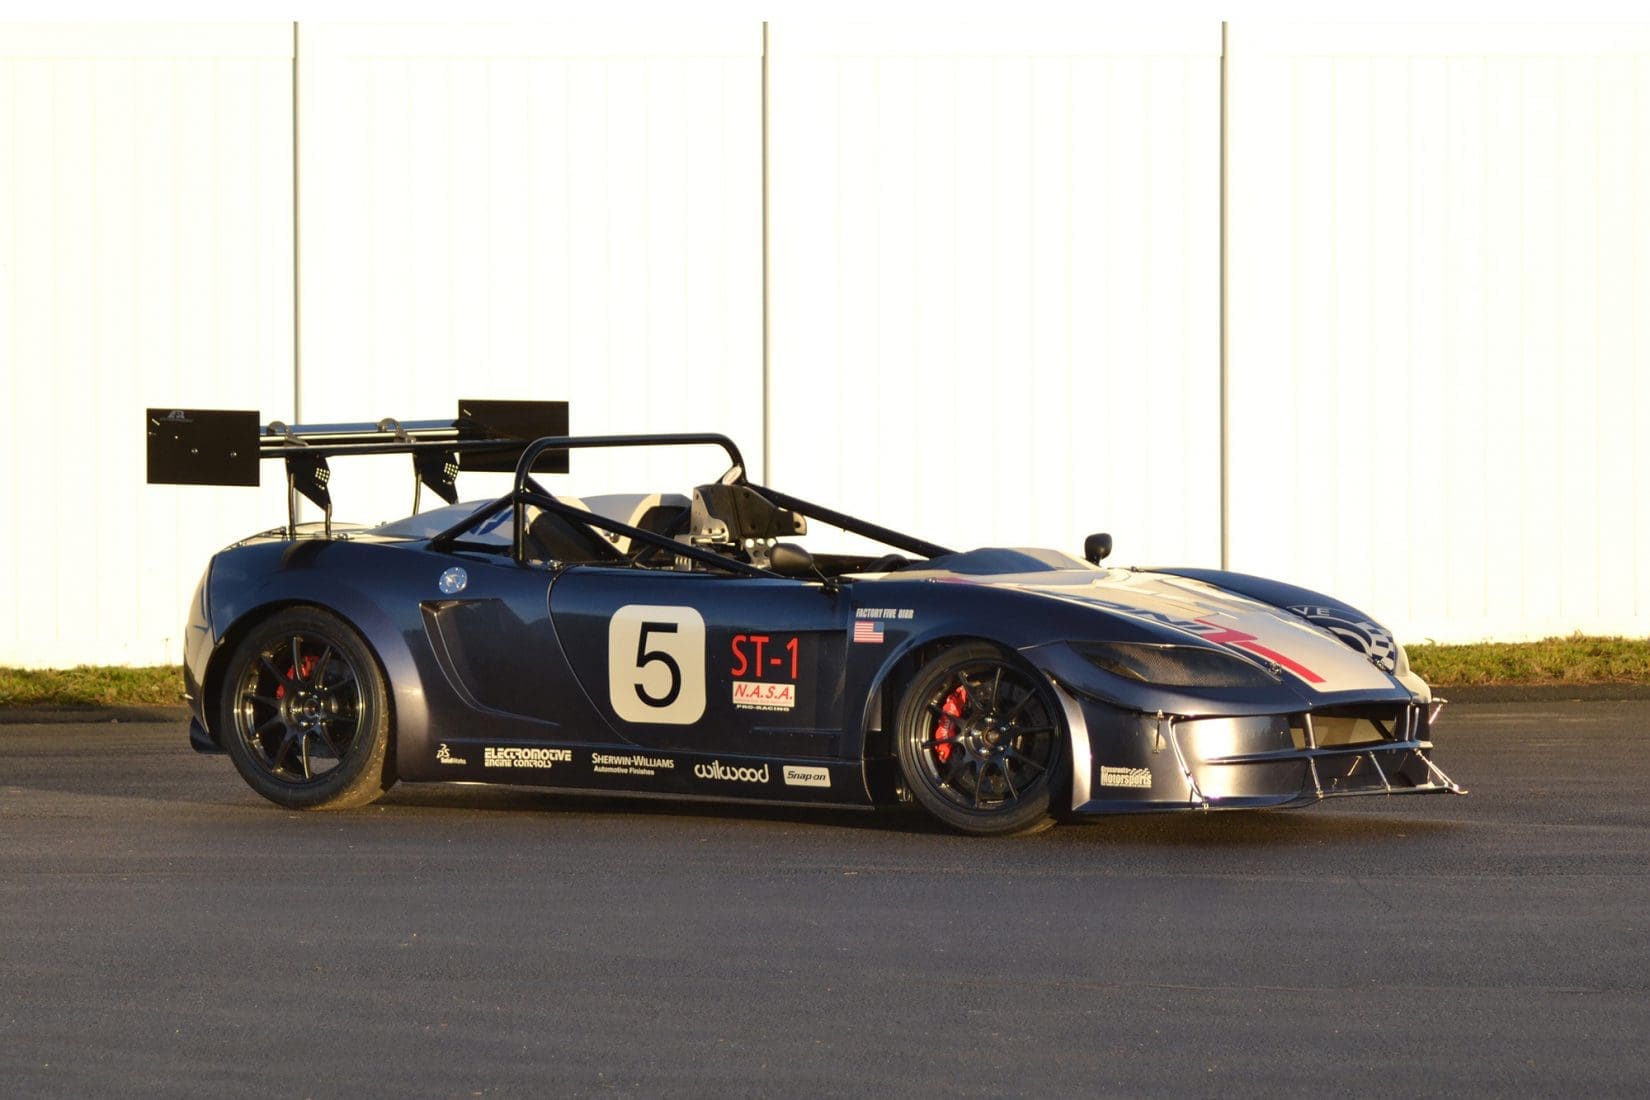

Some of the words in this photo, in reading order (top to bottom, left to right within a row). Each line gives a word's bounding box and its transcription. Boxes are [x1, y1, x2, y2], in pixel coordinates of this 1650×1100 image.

[634, 621, 682, 708] 5
[731, 634, 799, 679] ST-1
[735, 684, 793, 700] N.A.S.A.
[484, 747, 572, 762] ELECTROMOTIVE
[591, 752, 675, 769] SHERWIN-WILLIAMS
[593, 765, 628, 774] Automotive
[629, 767, 655, 776] Finishes
[694, 759, 769, 783] wilwood
